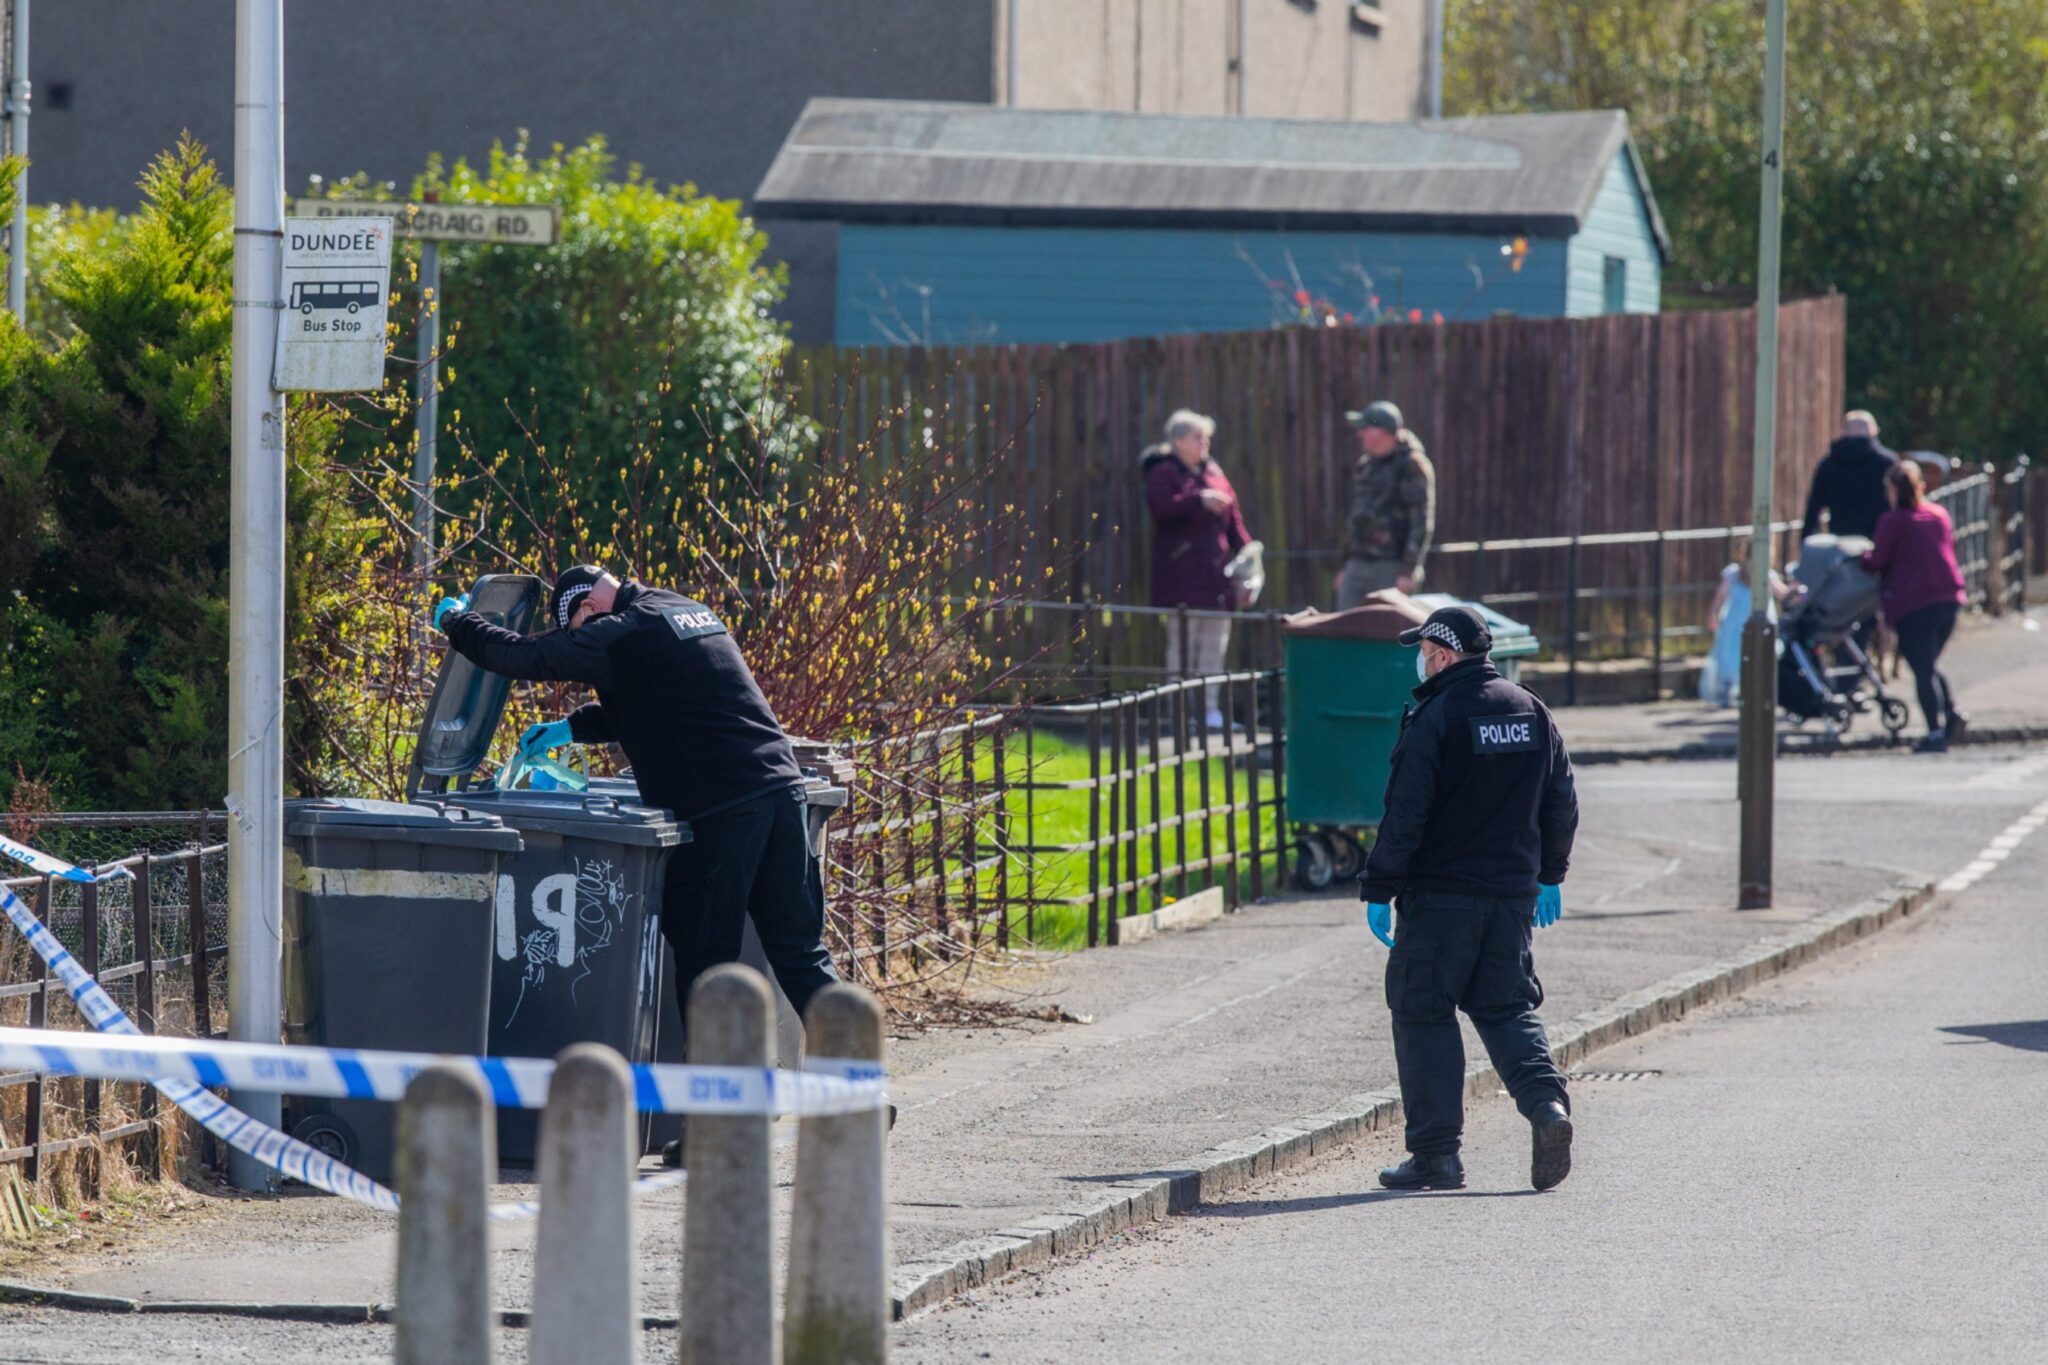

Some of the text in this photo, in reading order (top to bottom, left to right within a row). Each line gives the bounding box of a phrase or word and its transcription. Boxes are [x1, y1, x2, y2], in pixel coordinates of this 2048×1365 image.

[496, 215, 535, 238] RD.
[291, 234, 375, 251] DUNDEE
[303, 318, 362, 333] Bus Stop
[672, 611, 718, 630] POLICE
[1479, 723, 1531, 744] POLICE
[496, 873, 577, 968] 19
